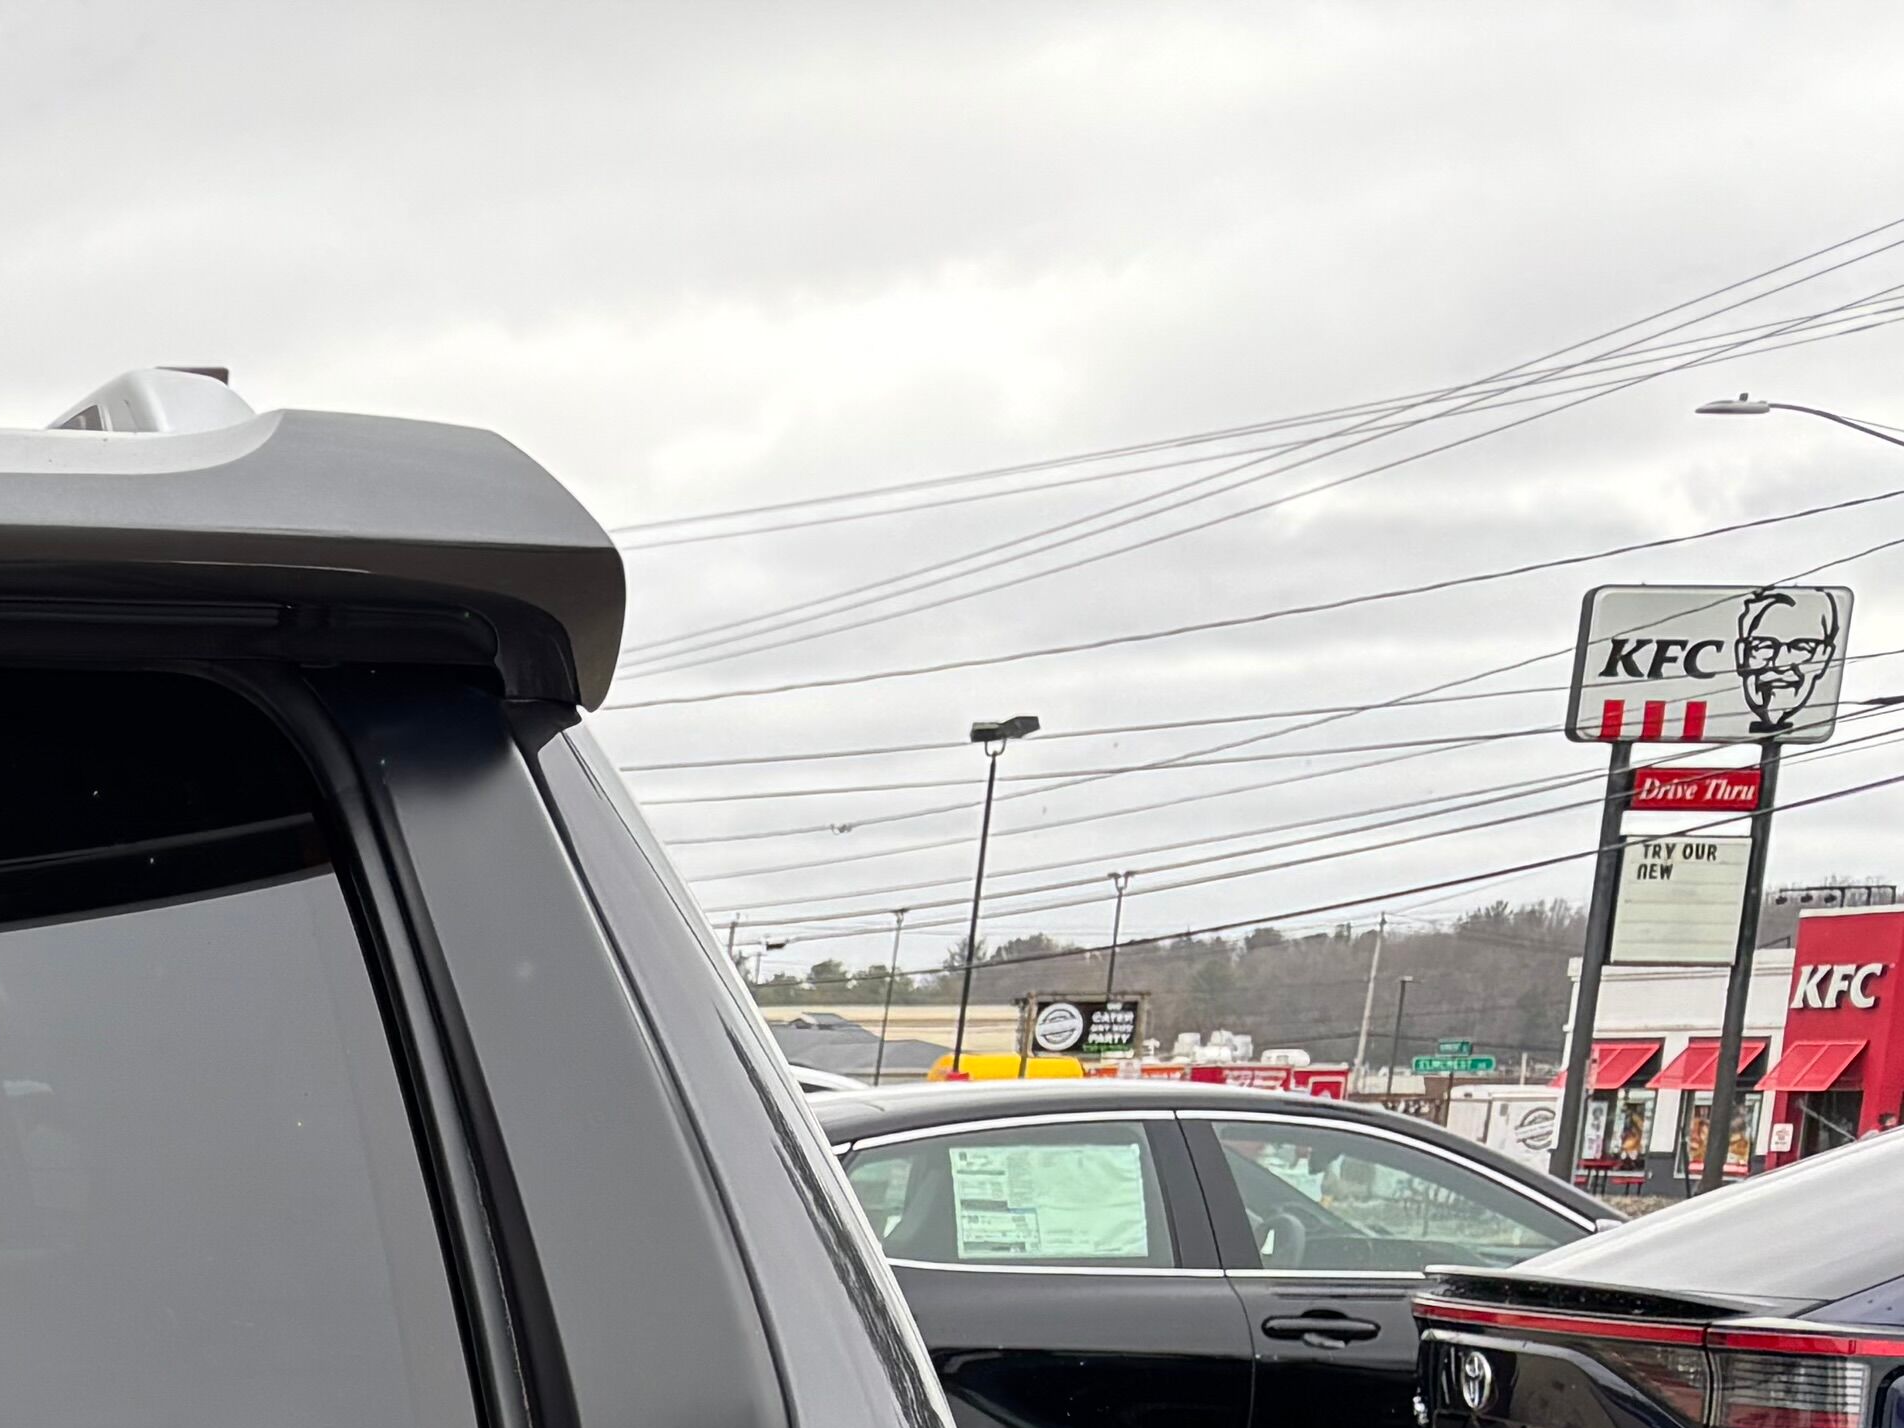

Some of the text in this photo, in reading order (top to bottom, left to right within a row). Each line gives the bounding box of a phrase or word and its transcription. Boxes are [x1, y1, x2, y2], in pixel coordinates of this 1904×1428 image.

[1598, 638, 1725, 680] KFC
[1640, 777, 1756, 801] Drive Thru
[1642, 842, 1718, 862] TRY OUR
[1636, 863, 1674, 880] NEW
[1790, 963, 1884, 1010] KFC
[1087, 1032, 1131, 1045] PARTY
